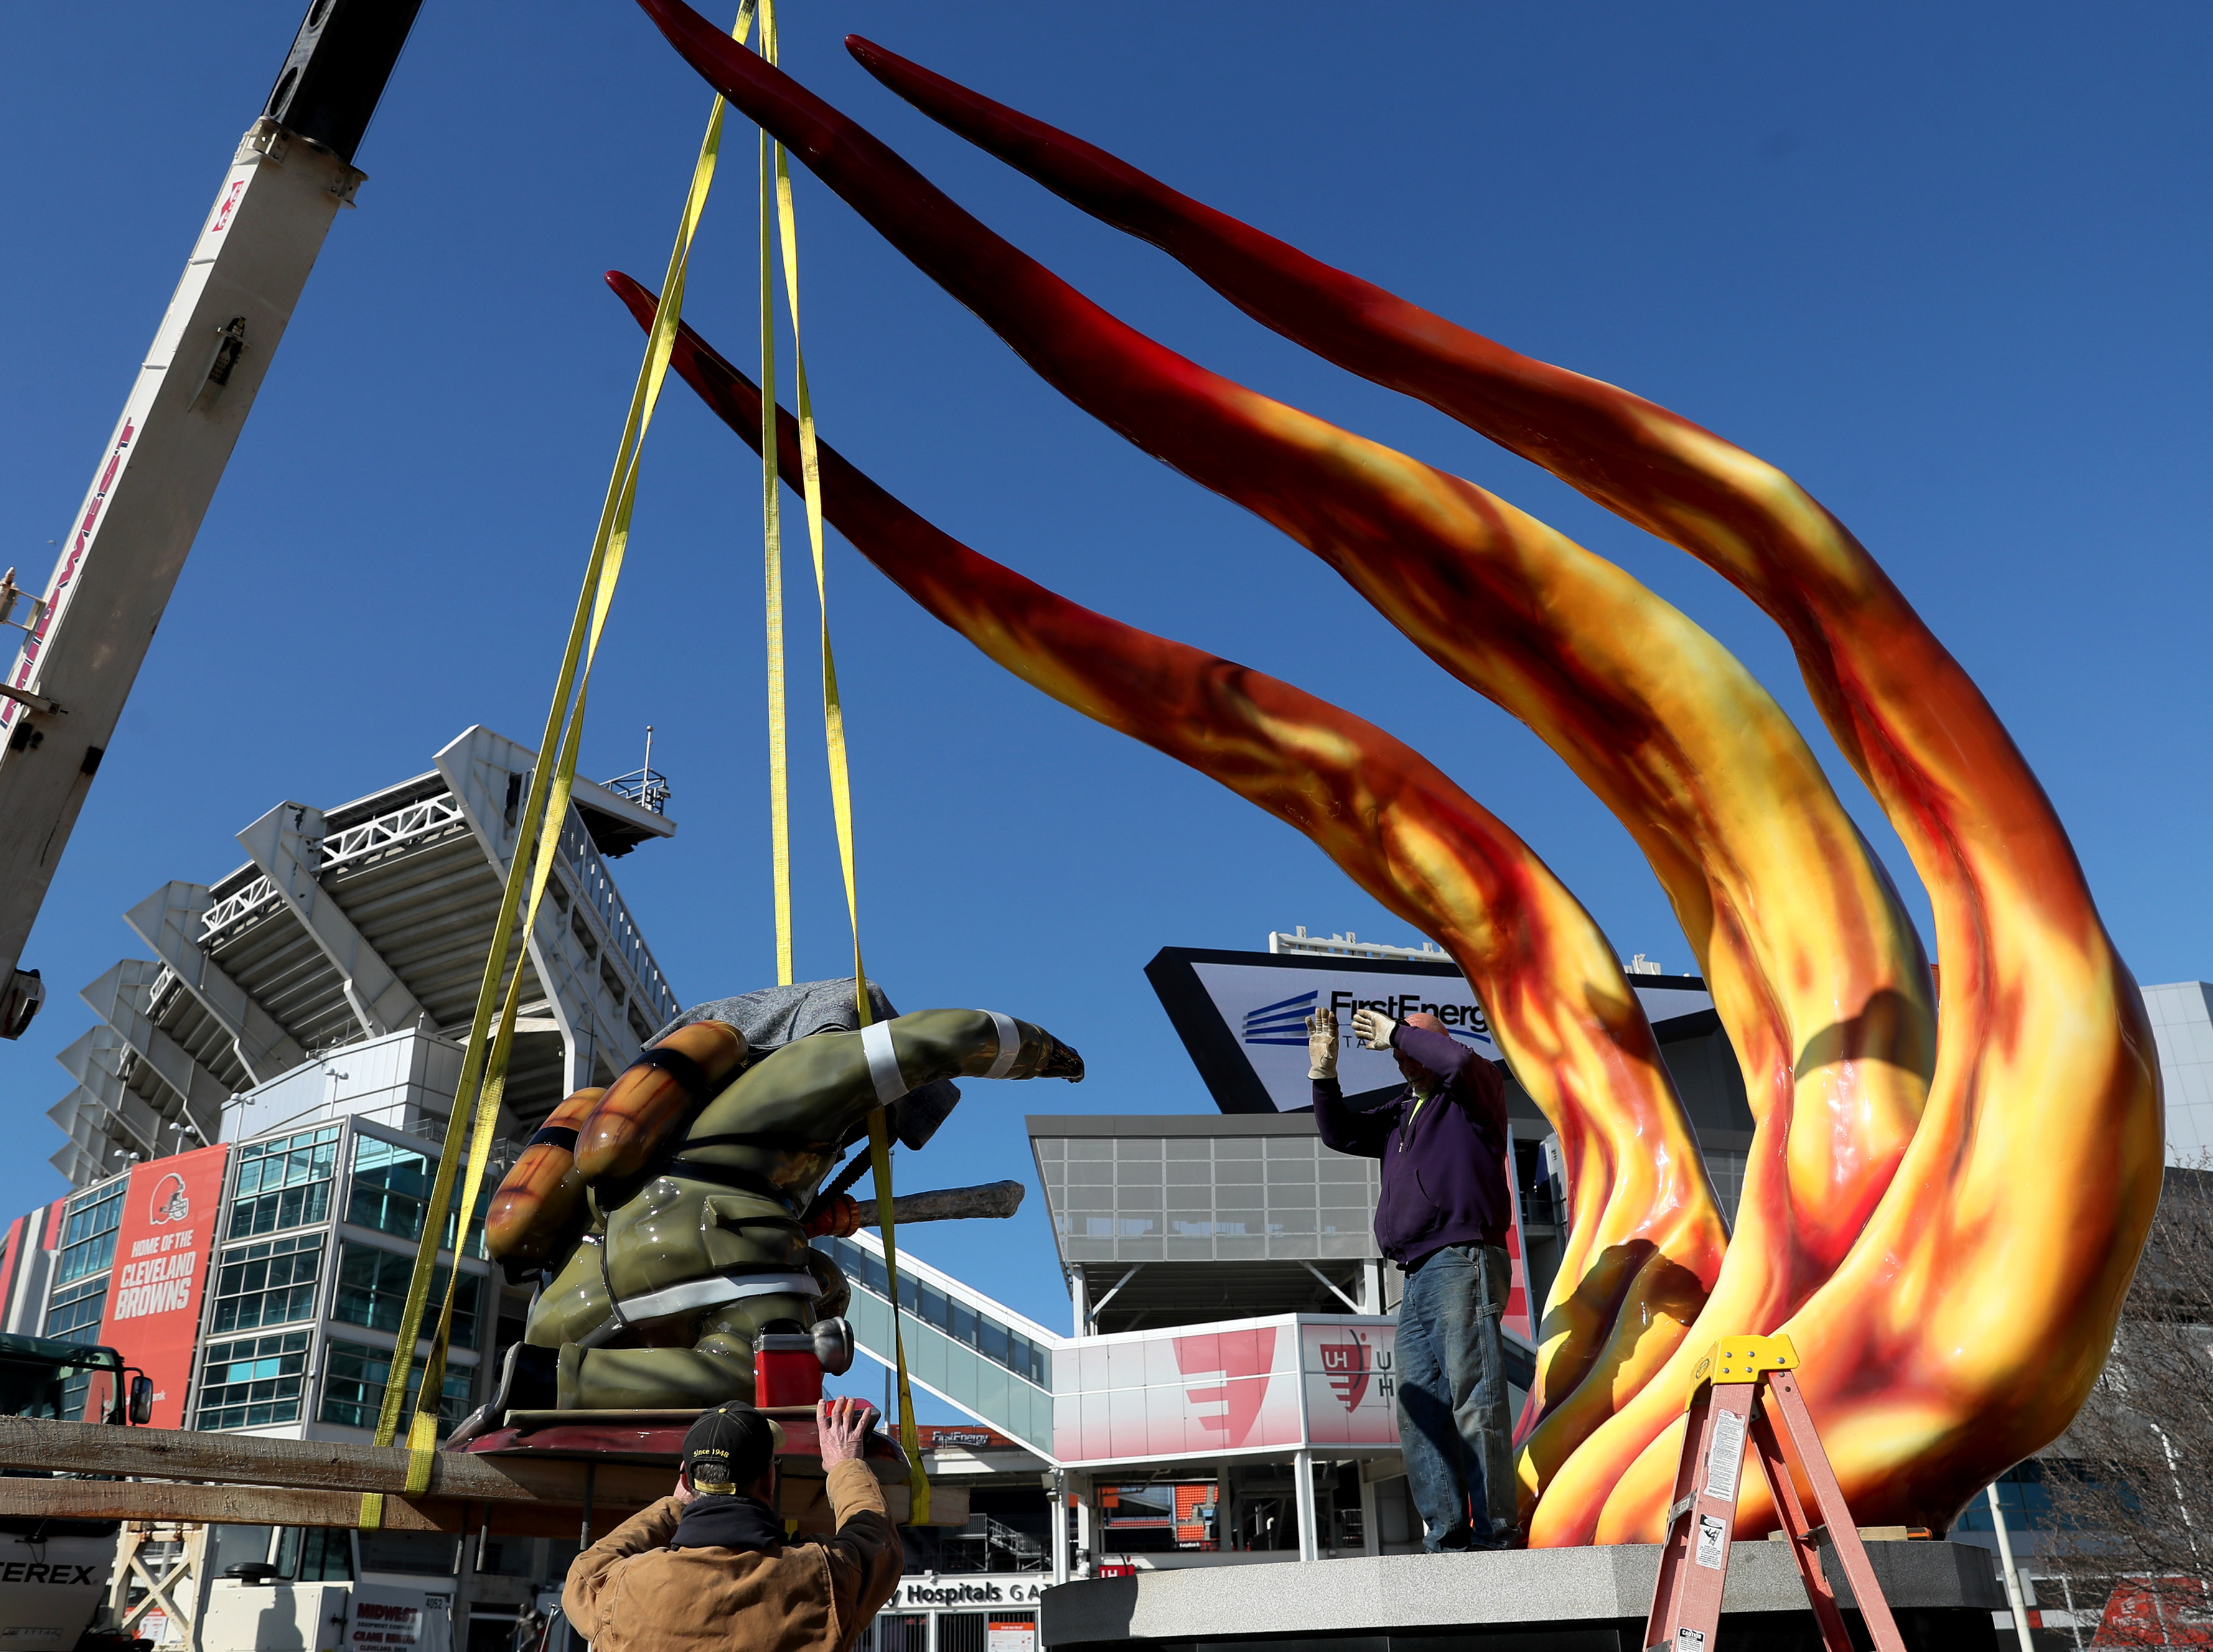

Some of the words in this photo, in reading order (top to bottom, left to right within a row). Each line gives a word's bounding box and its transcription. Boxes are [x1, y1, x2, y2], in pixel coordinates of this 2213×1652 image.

[1331, 991, 1490, 1033] FirstEnerg
[131, 1236, 161, 1258] HOME
[161, 1233, 175, 1252] OF
[174, 1229, 194, 1249] THE
[120, 1251, 197, 1289] CLEVELAND
[113, 1277, 192, 1321] BROWNS
[1324, 1351, 1348, 1368] UH
[693, 1449, 710, 1458] Since
[711, 1449, 729, 1458] 1948
[0, 1562, 96, 1585] EREX
[425, 1597, 443, 1610] 4052
[907, 1582, 1003, 1607] Hospitals
[357, 1602, 418, 1623] MIDWEST
[353, 1630, 384, 1643] CRANE
[1682, 1630, 1702, 1640] CAUTION
